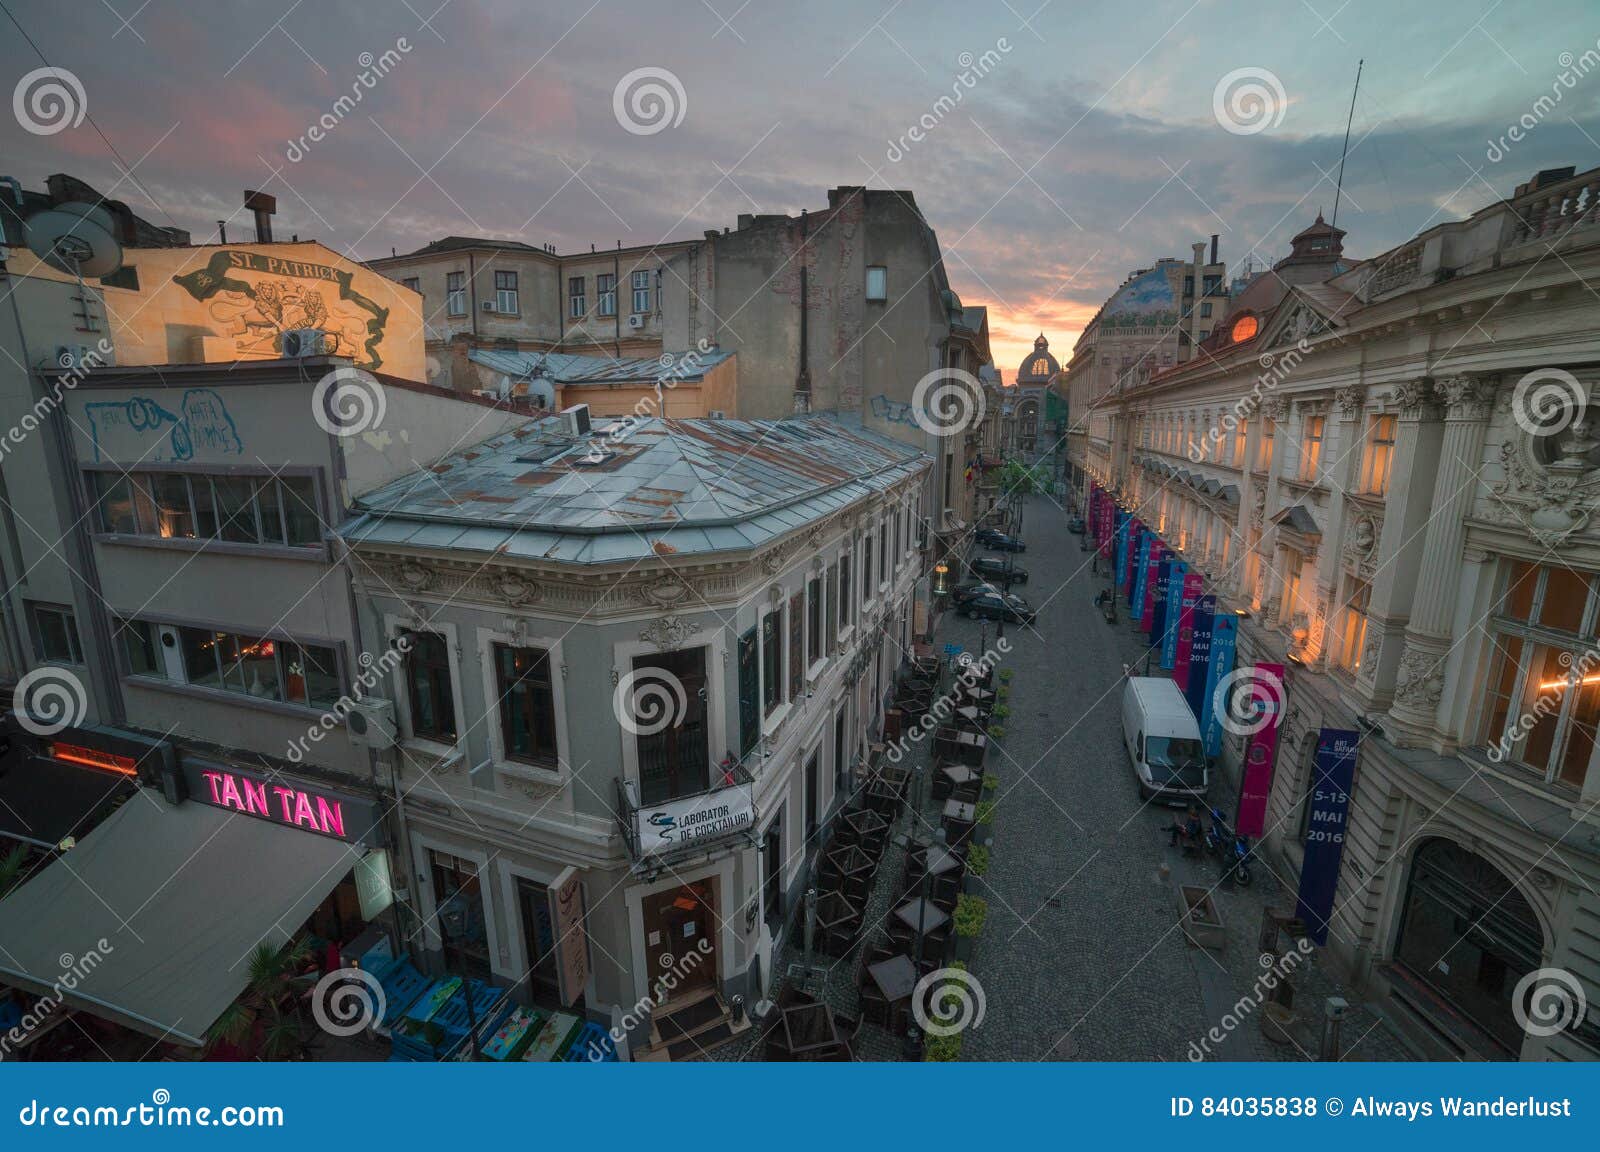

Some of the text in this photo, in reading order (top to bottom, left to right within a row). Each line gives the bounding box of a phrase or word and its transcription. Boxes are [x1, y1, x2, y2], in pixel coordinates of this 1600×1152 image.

[229, 251, 340, 282] ST. PATRICK
[1193, 631, 1211, 639] 5-15
[1213, 637, 1234, 647] 2016
[1192, 642, 1210, 651] MAI
[1190, 654, 1210, 663] 2016
[202, 771, 347, 837] TAN TAN
[1314, 790, 1347, 804] 5-15
[678, 805, 730, 828] LABORATOR
[1313, 809, 1343, 823] MAI
[680, 811, 750, 842] DE COCKTAILURI
[1307, 830, 1344, 844] 2016
